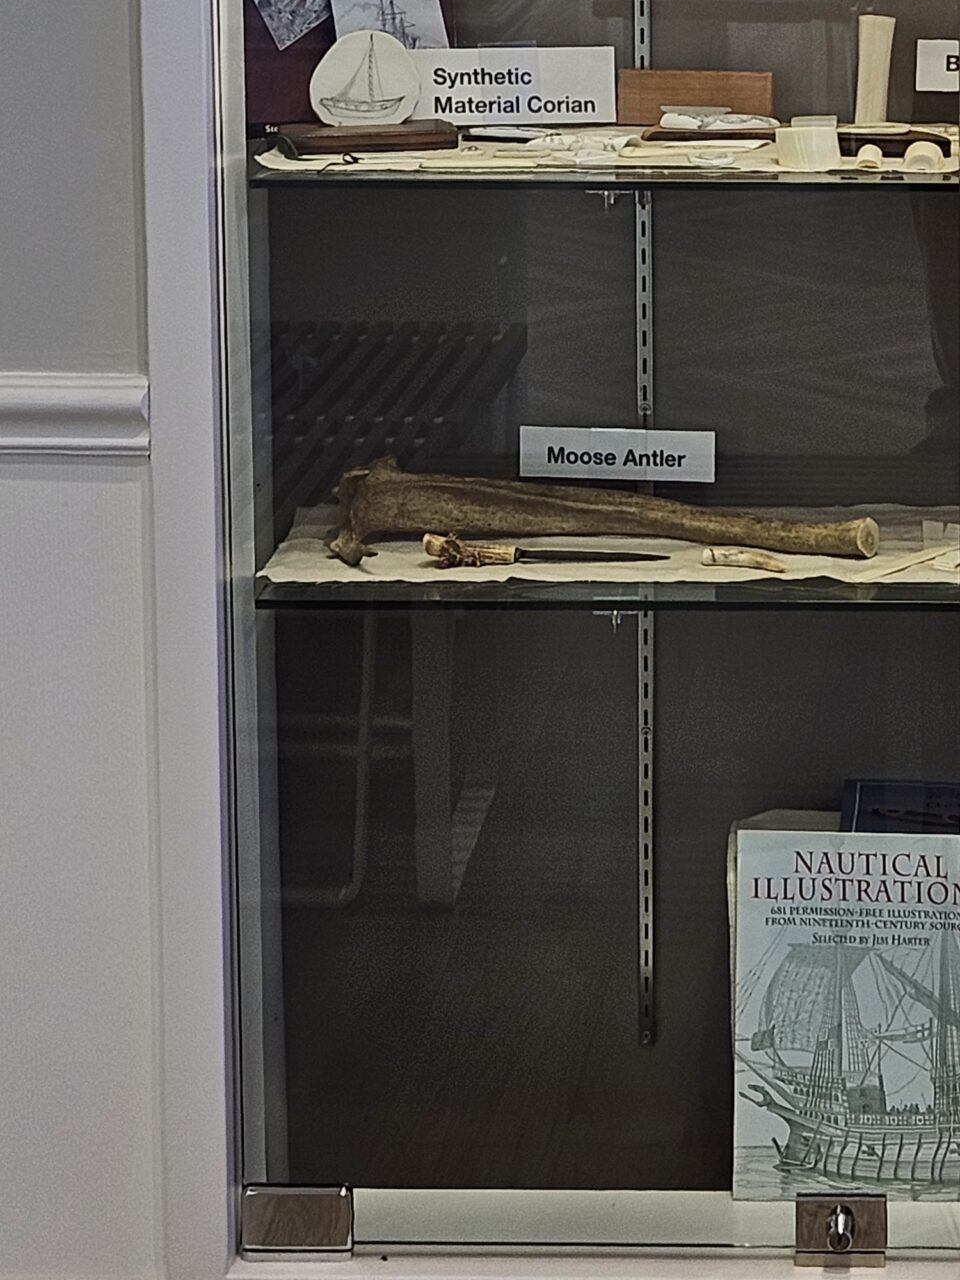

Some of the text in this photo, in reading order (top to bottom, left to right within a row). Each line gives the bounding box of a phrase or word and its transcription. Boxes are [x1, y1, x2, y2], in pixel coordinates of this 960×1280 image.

[432, 67, 533, 90] Synthetic
[434, 95, 596, 115] Material Corian
[546, 445, 687, 469] Moose Antler
[793, 850, 949, 879] NAUTICAL
[765, 917, 797, 927] FROM
[770, 907, 787, 916] 681
[789, 907, 883, 919] PERMISSION-FREE
